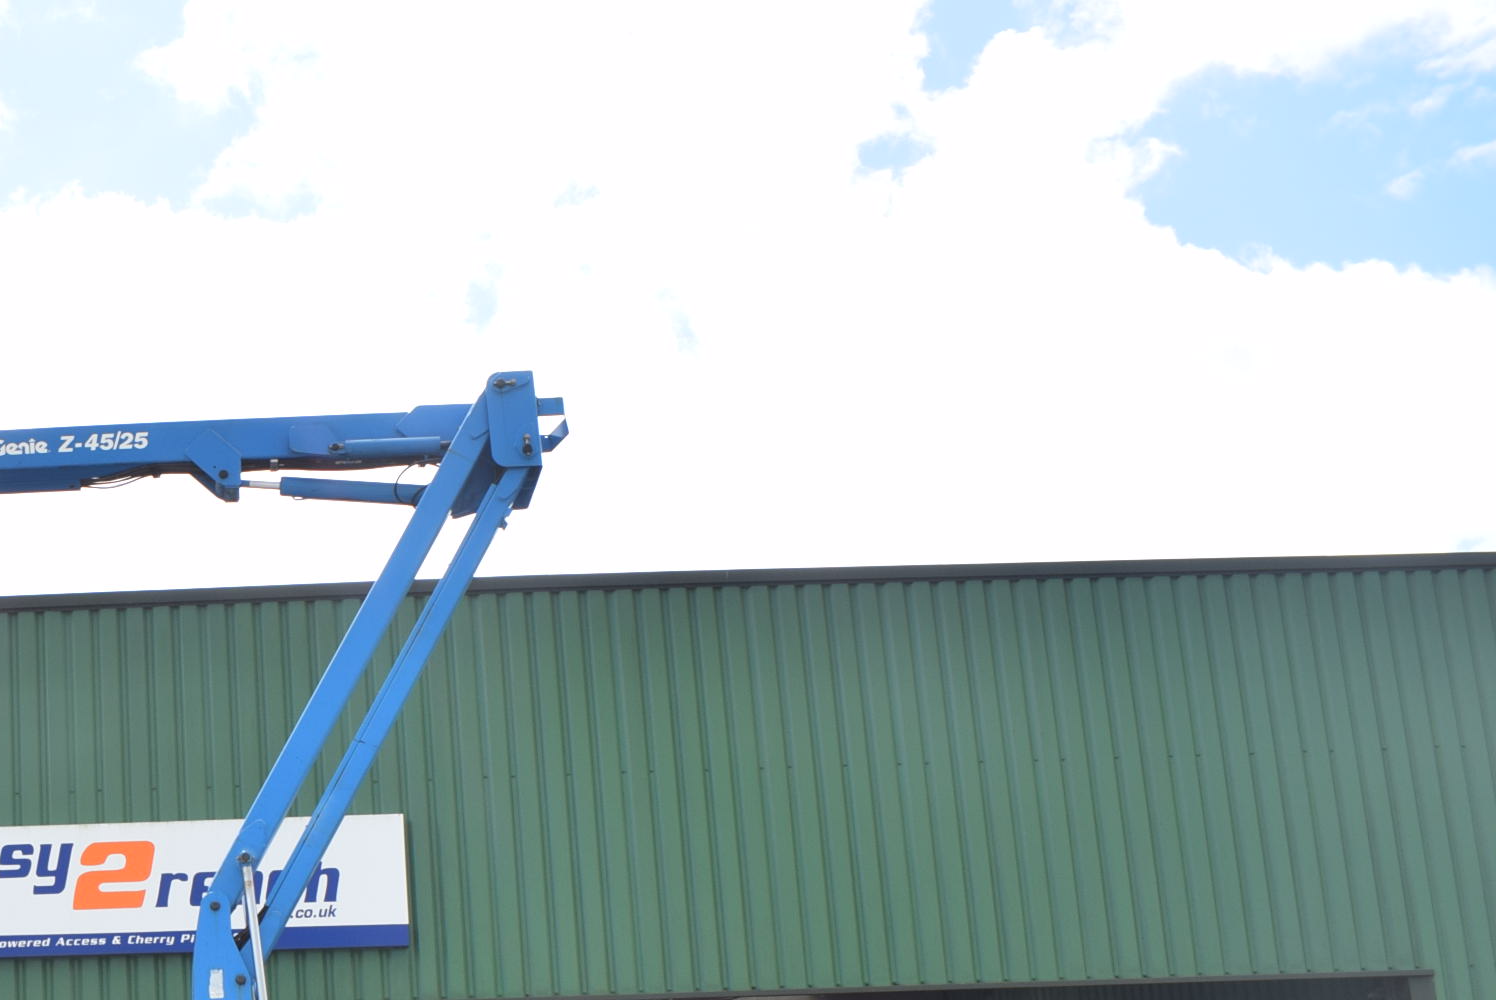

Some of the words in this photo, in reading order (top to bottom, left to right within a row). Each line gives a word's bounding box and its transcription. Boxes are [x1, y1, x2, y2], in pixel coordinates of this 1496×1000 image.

[58, 431, 149, 453] Z-45/25
[55, 936, 107, 946] Access
[112, 935, 122, 945] &
[128, 934, 175, 946] Cherry
